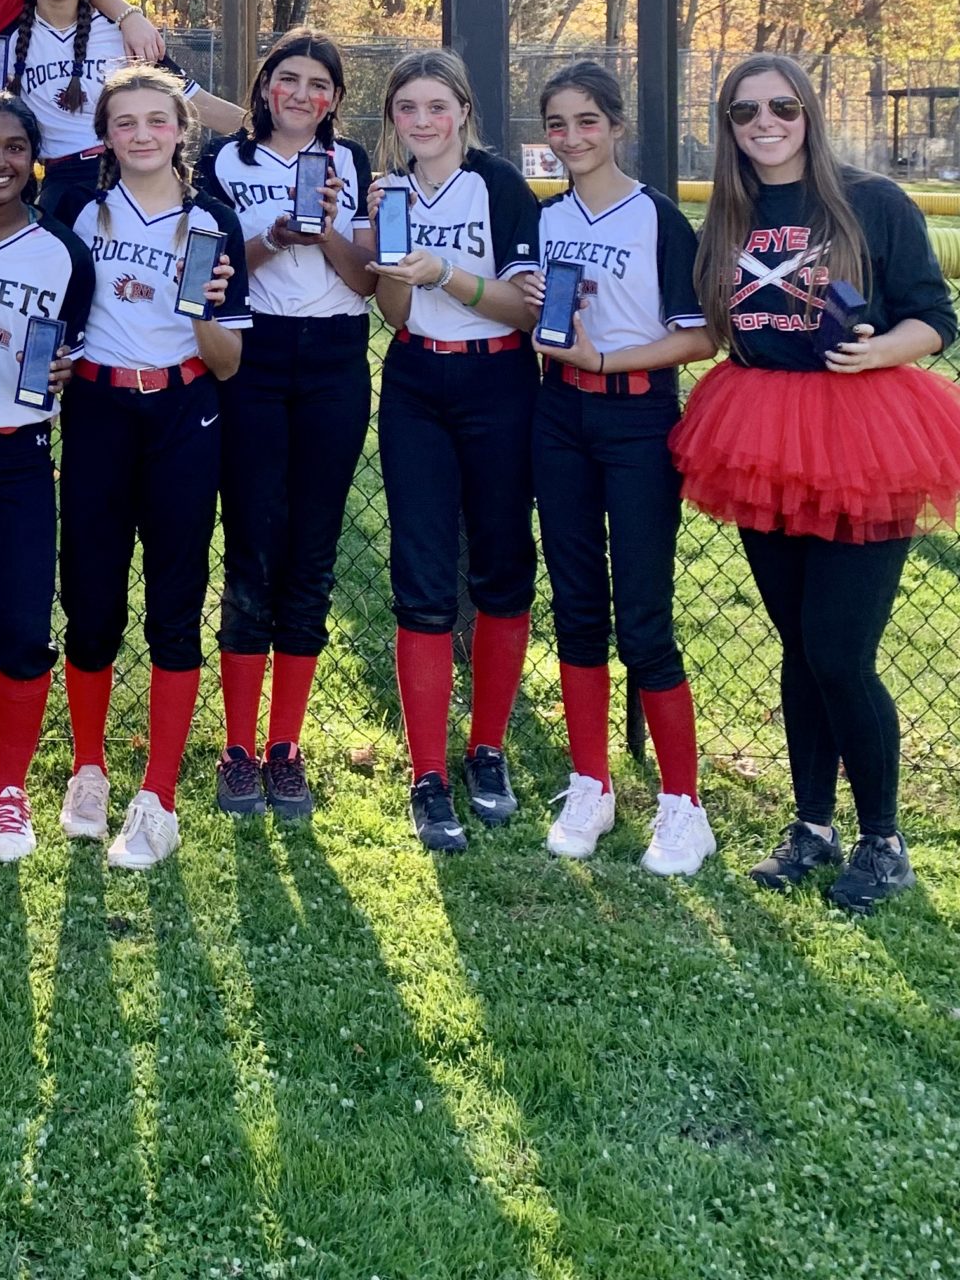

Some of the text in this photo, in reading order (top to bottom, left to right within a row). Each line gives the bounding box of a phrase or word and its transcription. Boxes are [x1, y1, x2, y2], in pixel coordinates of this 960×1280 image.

[25, 59, 106, 95] ROCKTS
[411, 221, 485, 258] KETS
[90, 236, 179, 286] ROCKET
